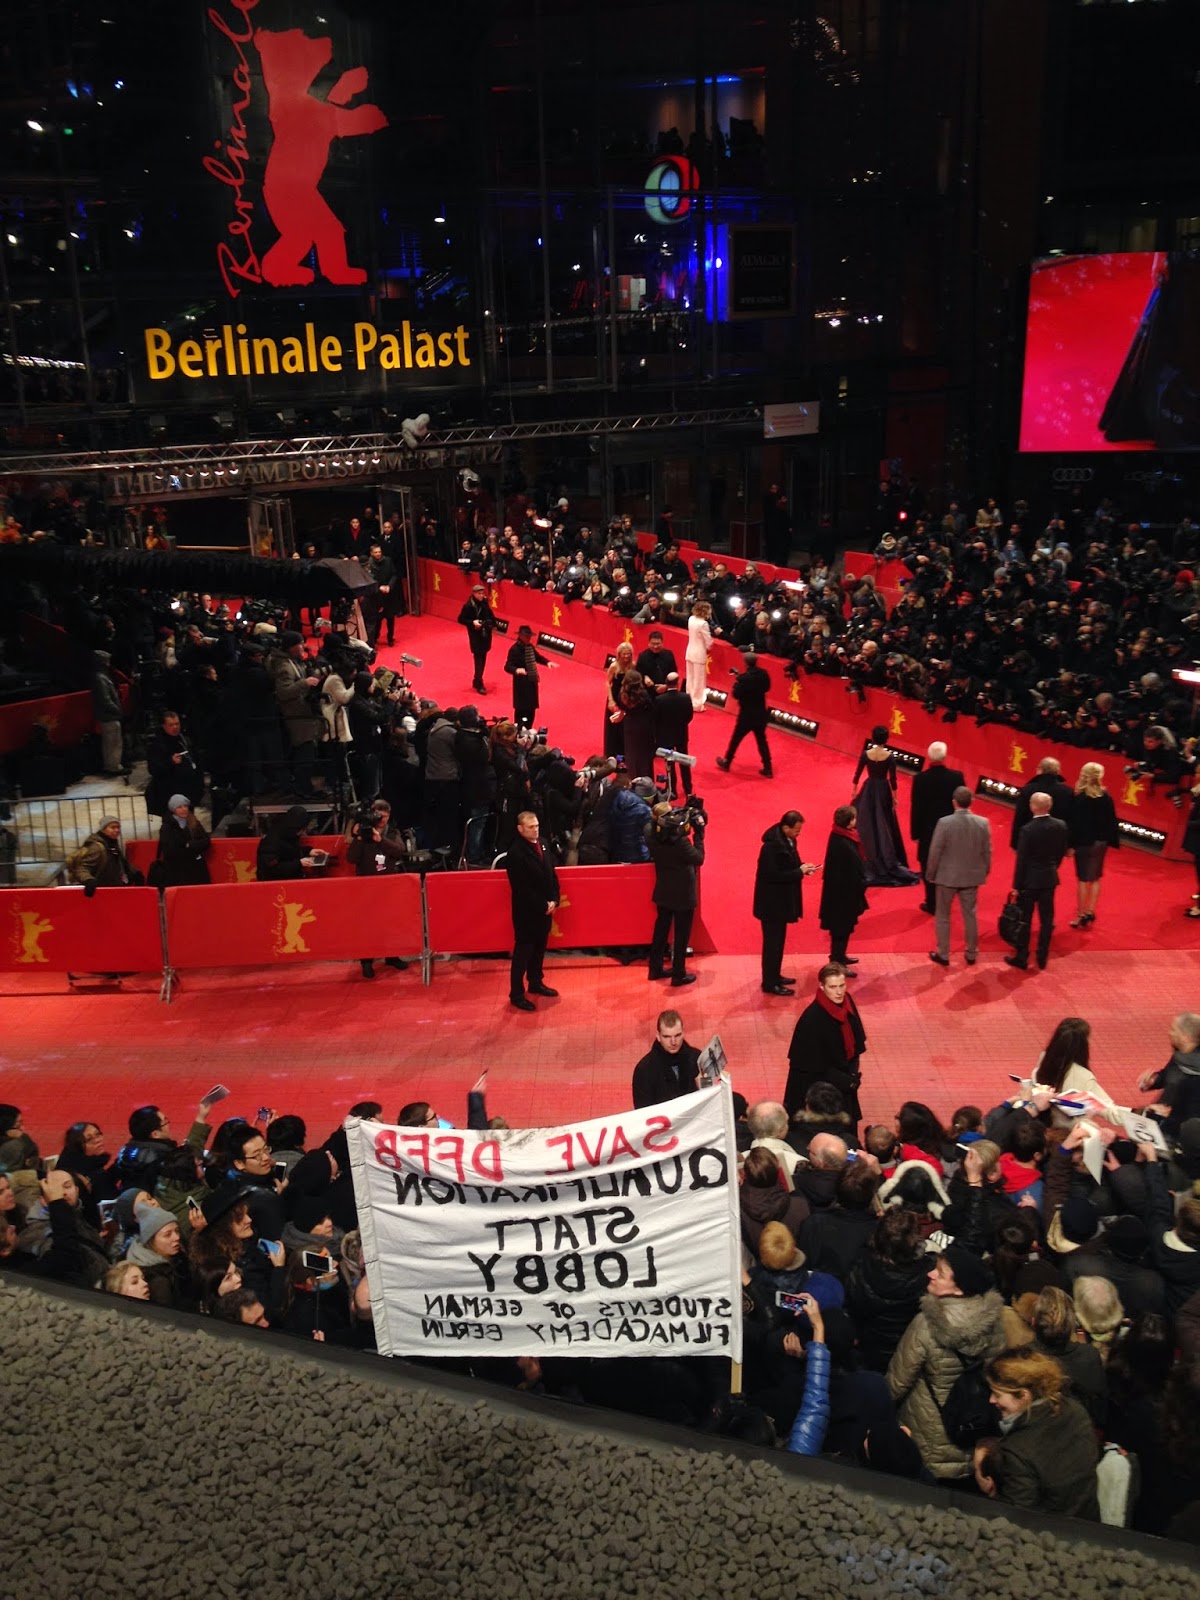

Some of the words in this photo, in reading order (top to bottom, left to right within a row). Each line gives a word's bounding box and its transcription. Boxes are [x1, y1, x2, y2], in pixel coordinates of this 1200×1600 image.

[145, 322, 342, 379] Berlinale
[354, 320, 471, 370] Palast
[241, 462, 286, 485] AM
